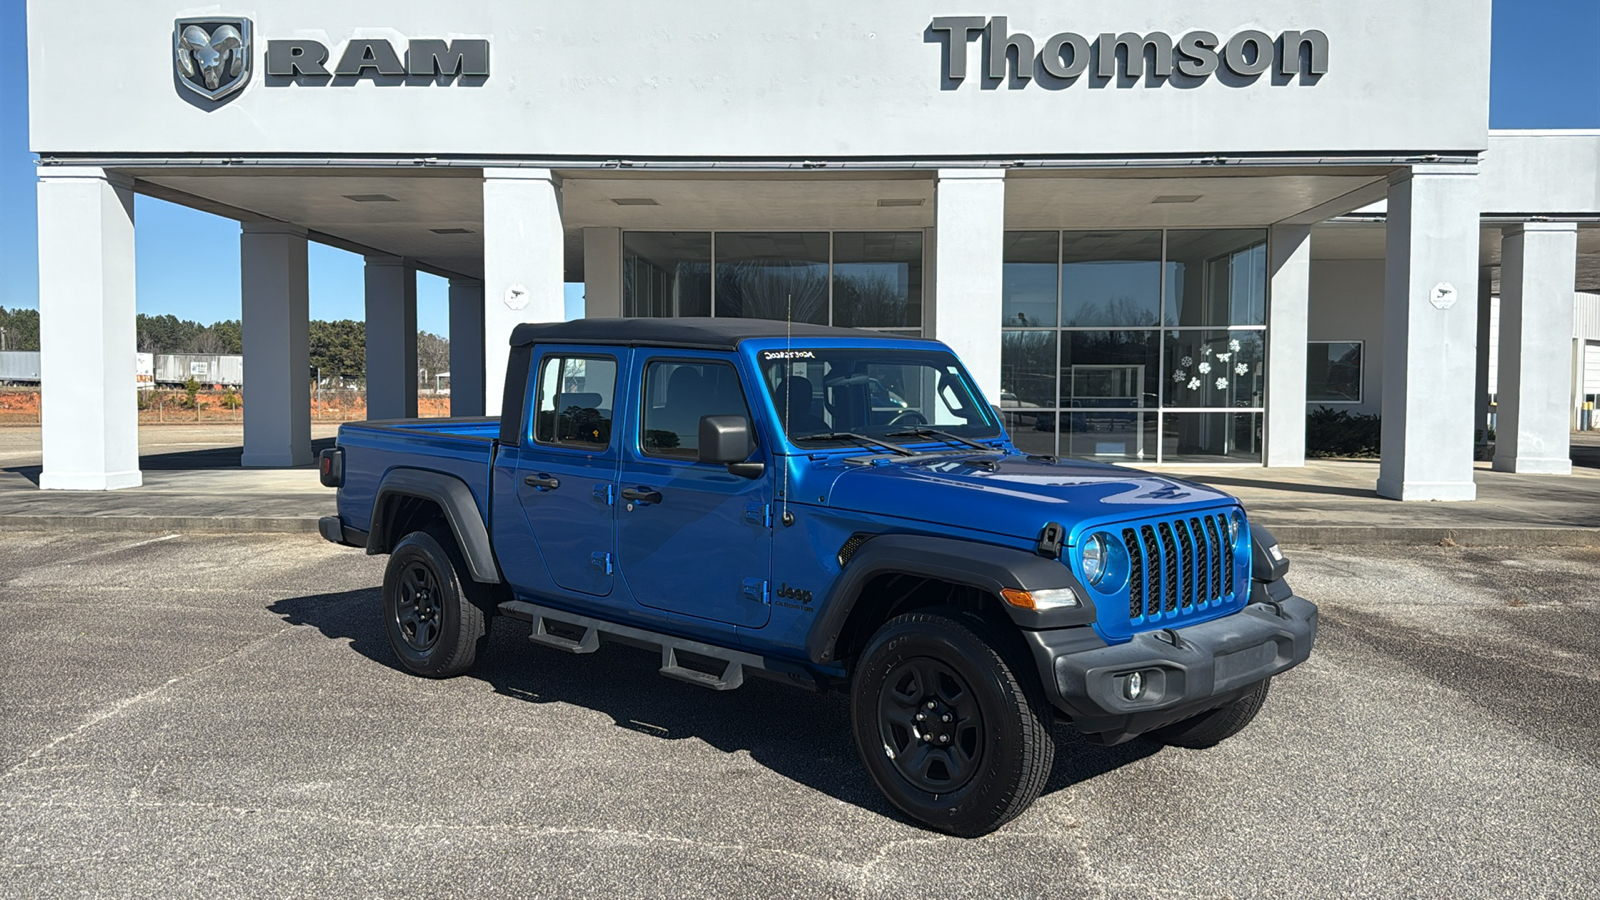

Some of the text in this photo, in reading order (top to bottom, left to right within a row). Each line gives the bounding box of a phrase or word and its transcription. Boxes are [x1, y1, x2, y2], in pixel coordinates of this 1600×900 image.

[266, 39, 491, 77] RAM
[930, 16, 1330, 80] Thomson
[777, 583, 813, 605] Jeep
